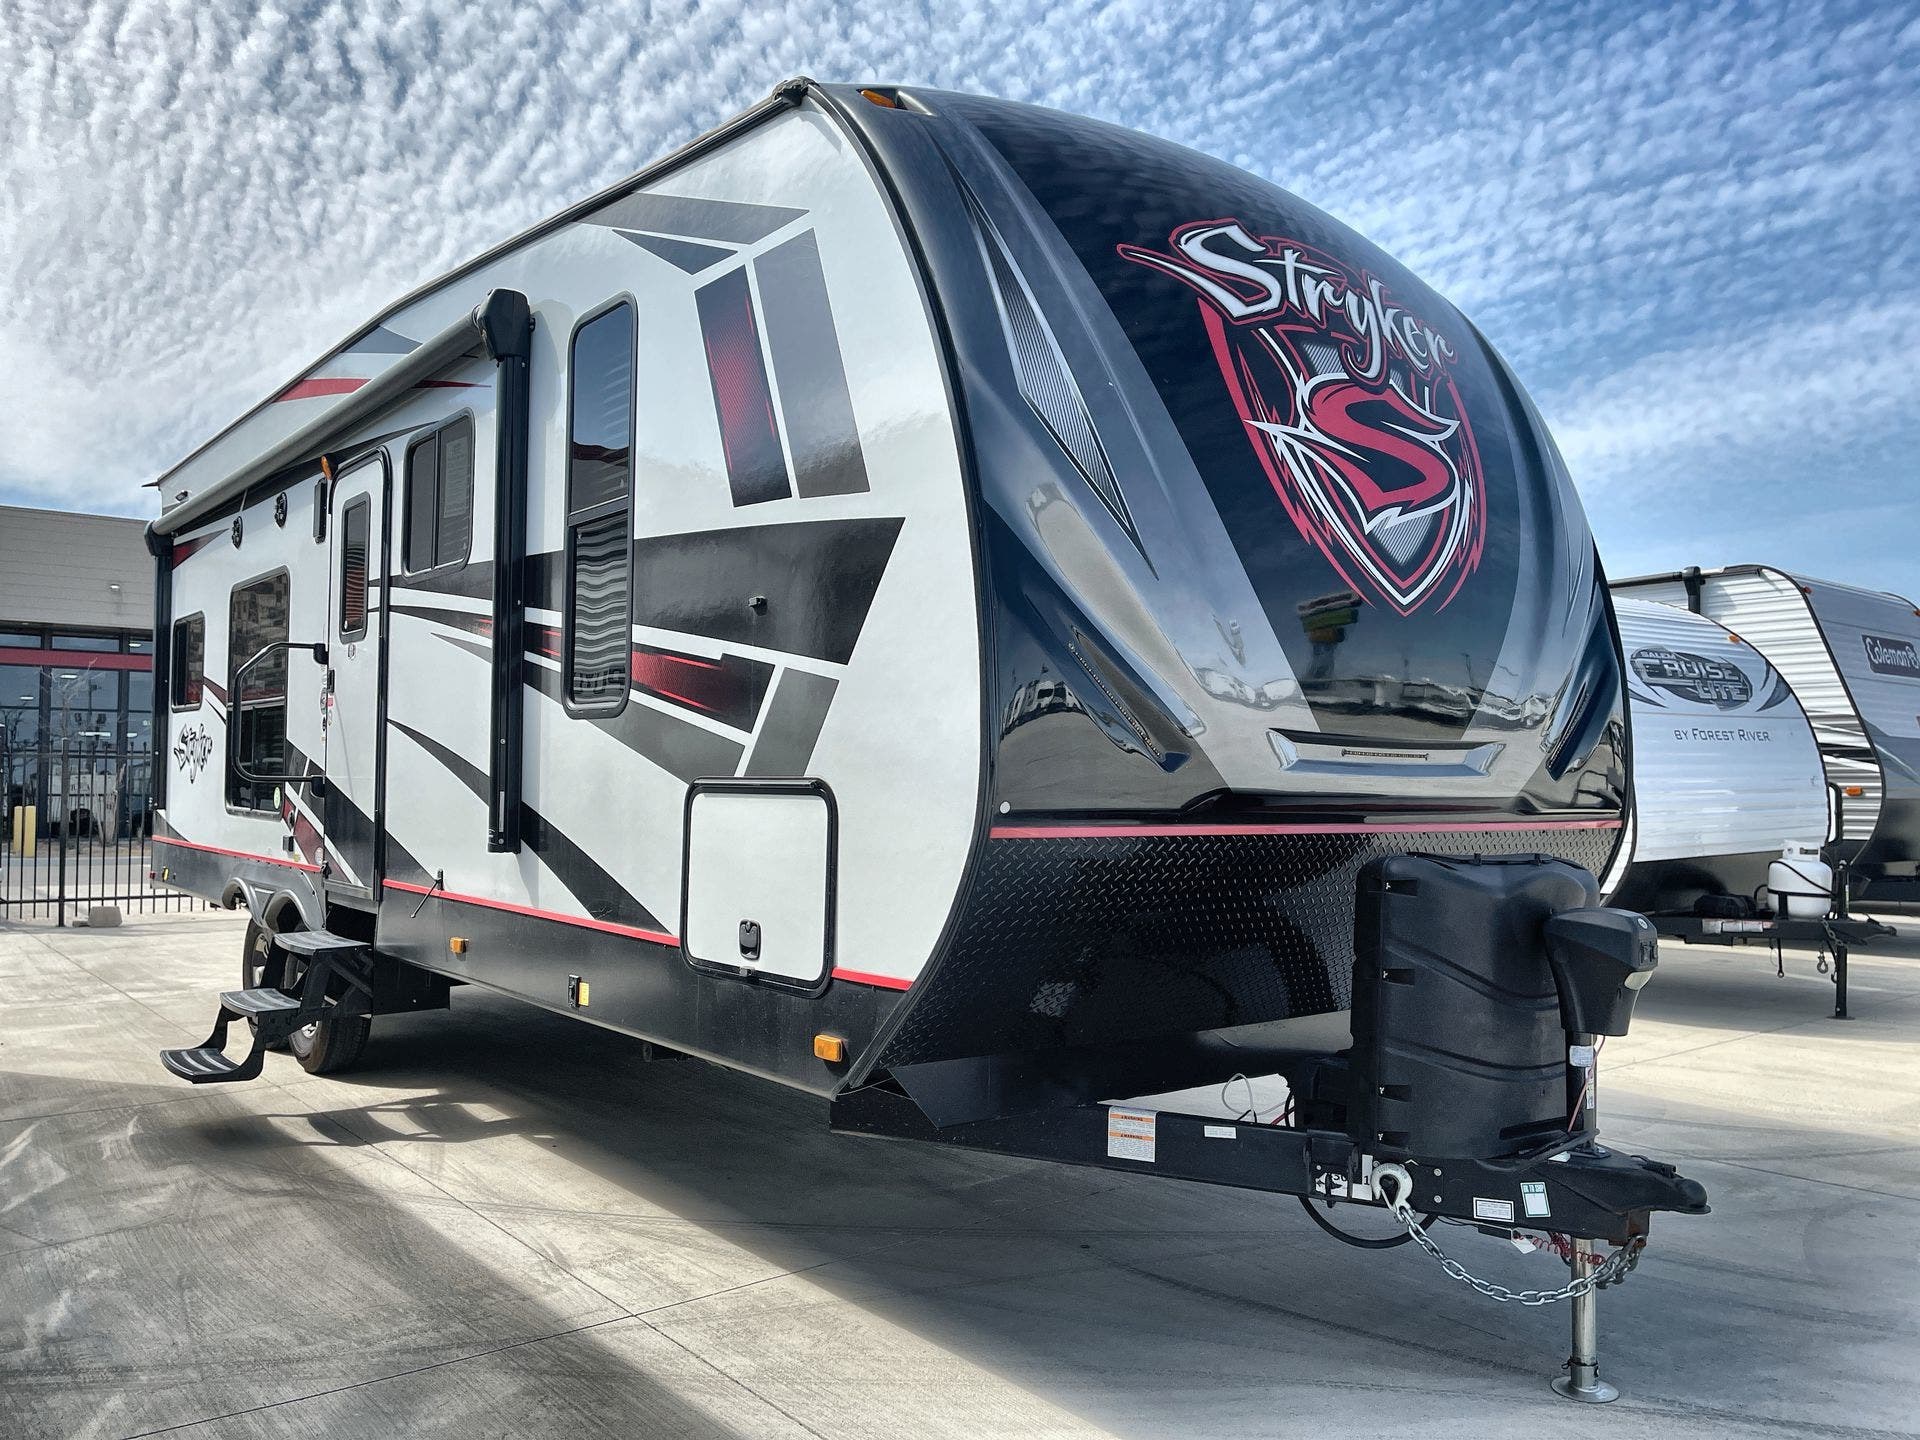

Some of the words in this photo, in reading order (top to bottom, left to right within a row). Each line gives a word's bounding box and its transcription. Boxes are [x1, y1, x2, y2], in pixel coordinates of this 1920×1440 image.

[1121, 222, 1456, 380] Stryker
[1866, 637, 1911, 667] Coleman
[1634, 658, 1739, 685] CRUISE
[1694, 680, 1749, 701] LITE
[1674, 729, 1689, 741] BY
[1692, 728, 1735, 741] FOREST
[1738, 729, 1770, 742] RIVER
